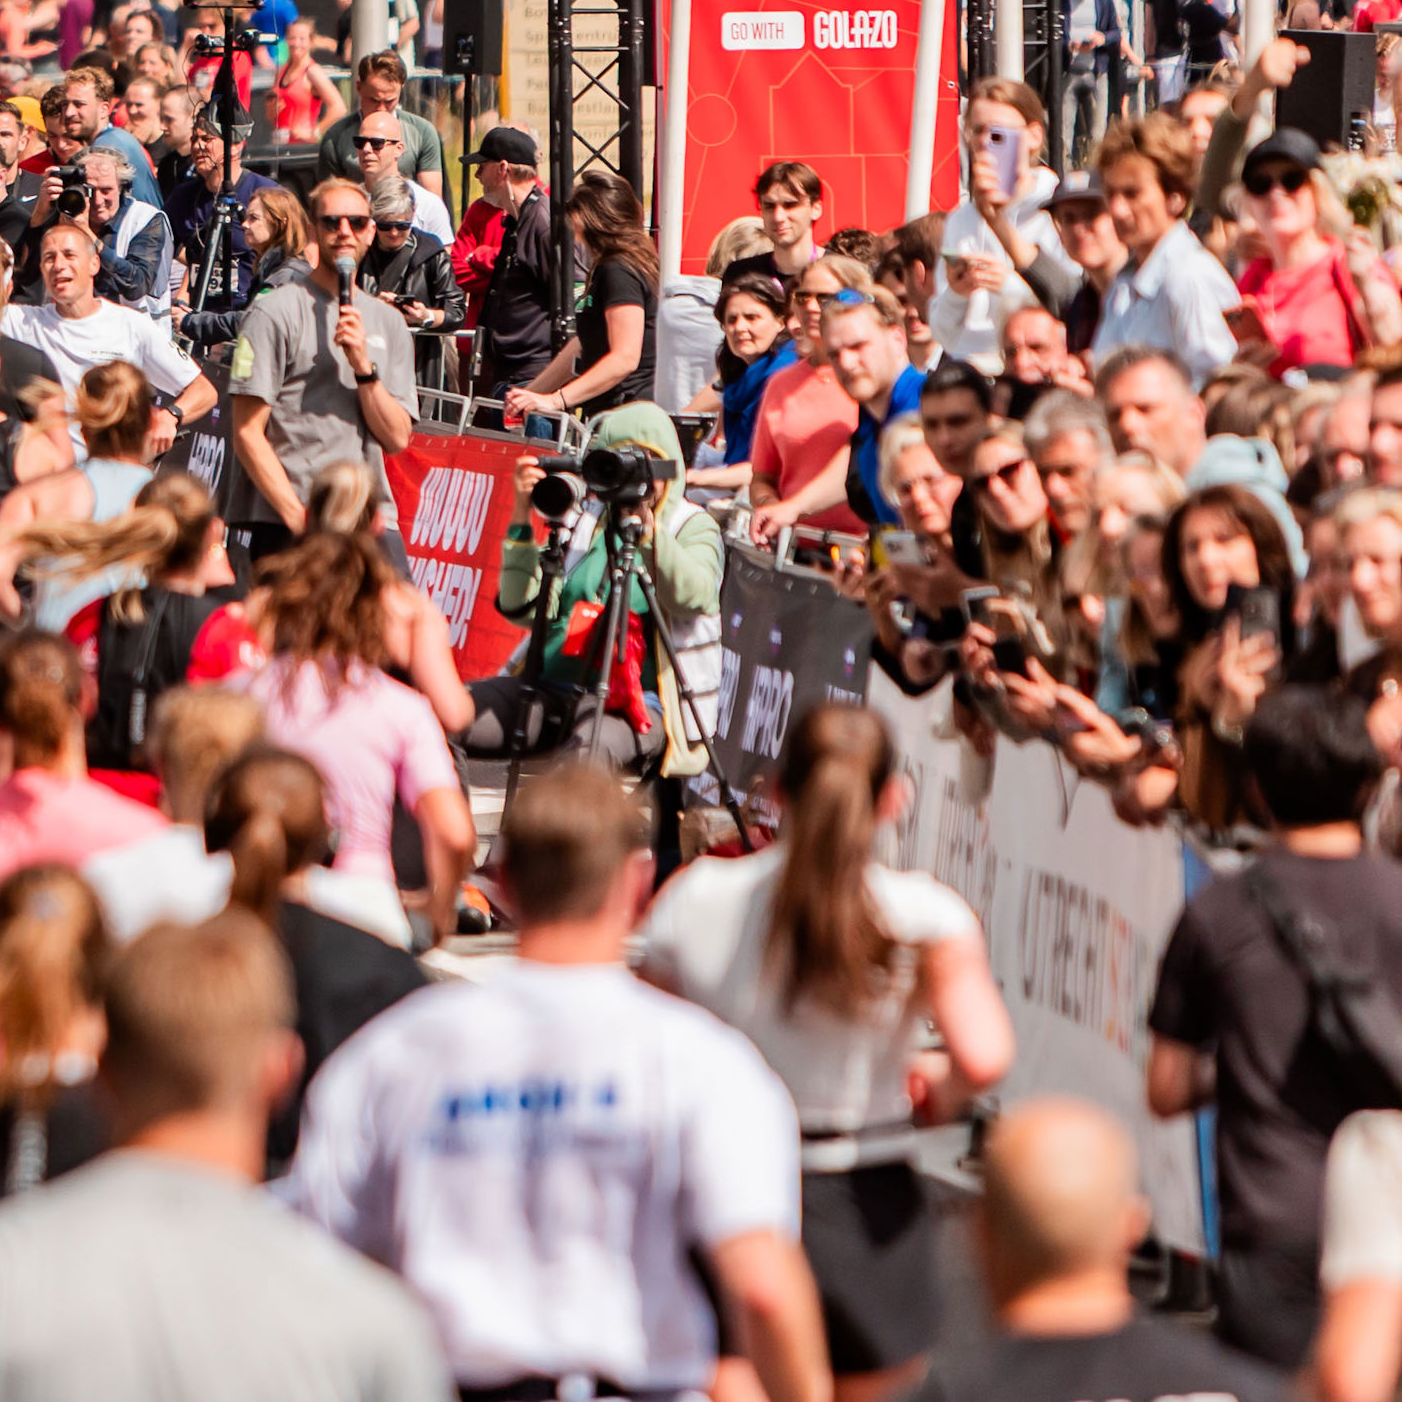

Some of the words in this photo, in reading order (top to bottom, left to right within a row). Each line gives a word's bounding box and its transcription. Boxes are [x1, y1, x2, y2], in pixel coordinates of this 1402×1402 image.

[730, 23, 750, 41] GO
[752, 22, 785, 40] WITH
[813, 10, 898, 49] GOLAZO
